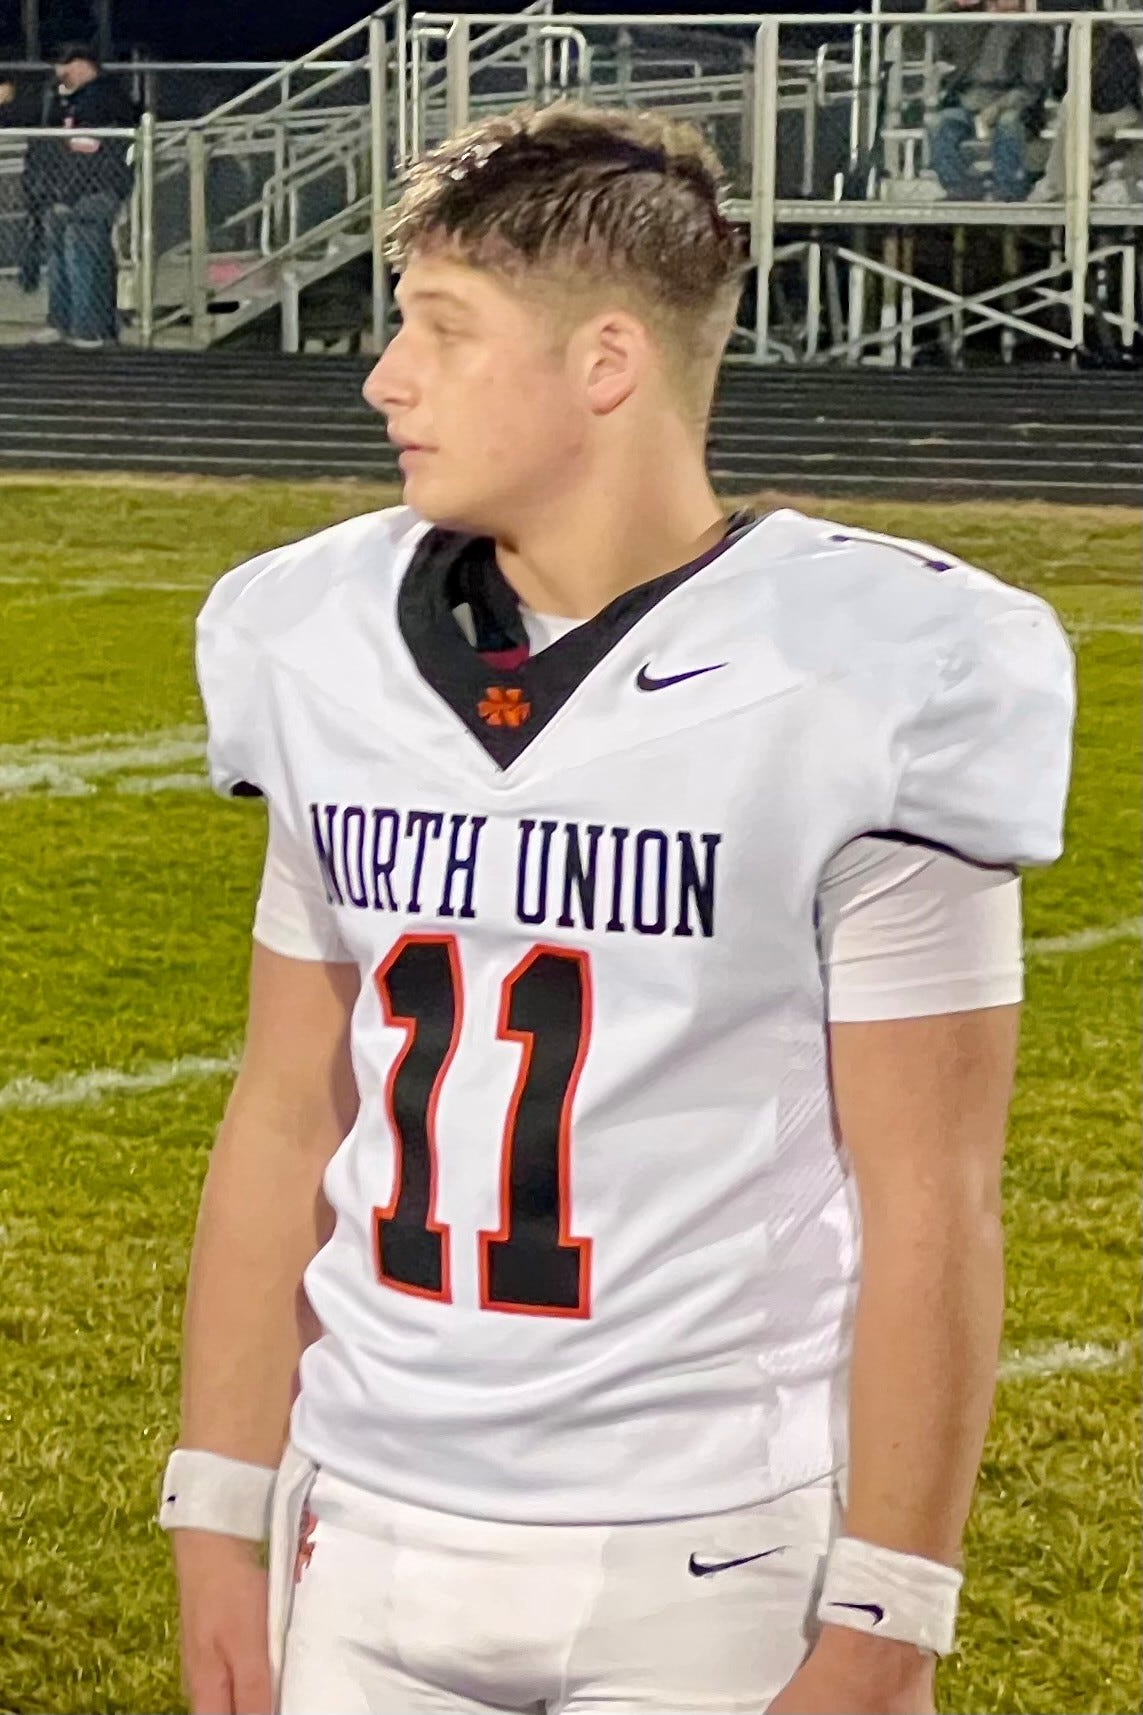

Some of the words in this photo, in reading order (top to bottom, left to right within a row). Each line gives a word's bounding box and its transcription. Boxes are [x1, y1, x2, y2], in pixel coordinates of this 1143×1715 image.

[310, 804, 488, 919] NORTH
[516, 818, 722, 938] UNION
[371, 933, 594, 1320] 11
